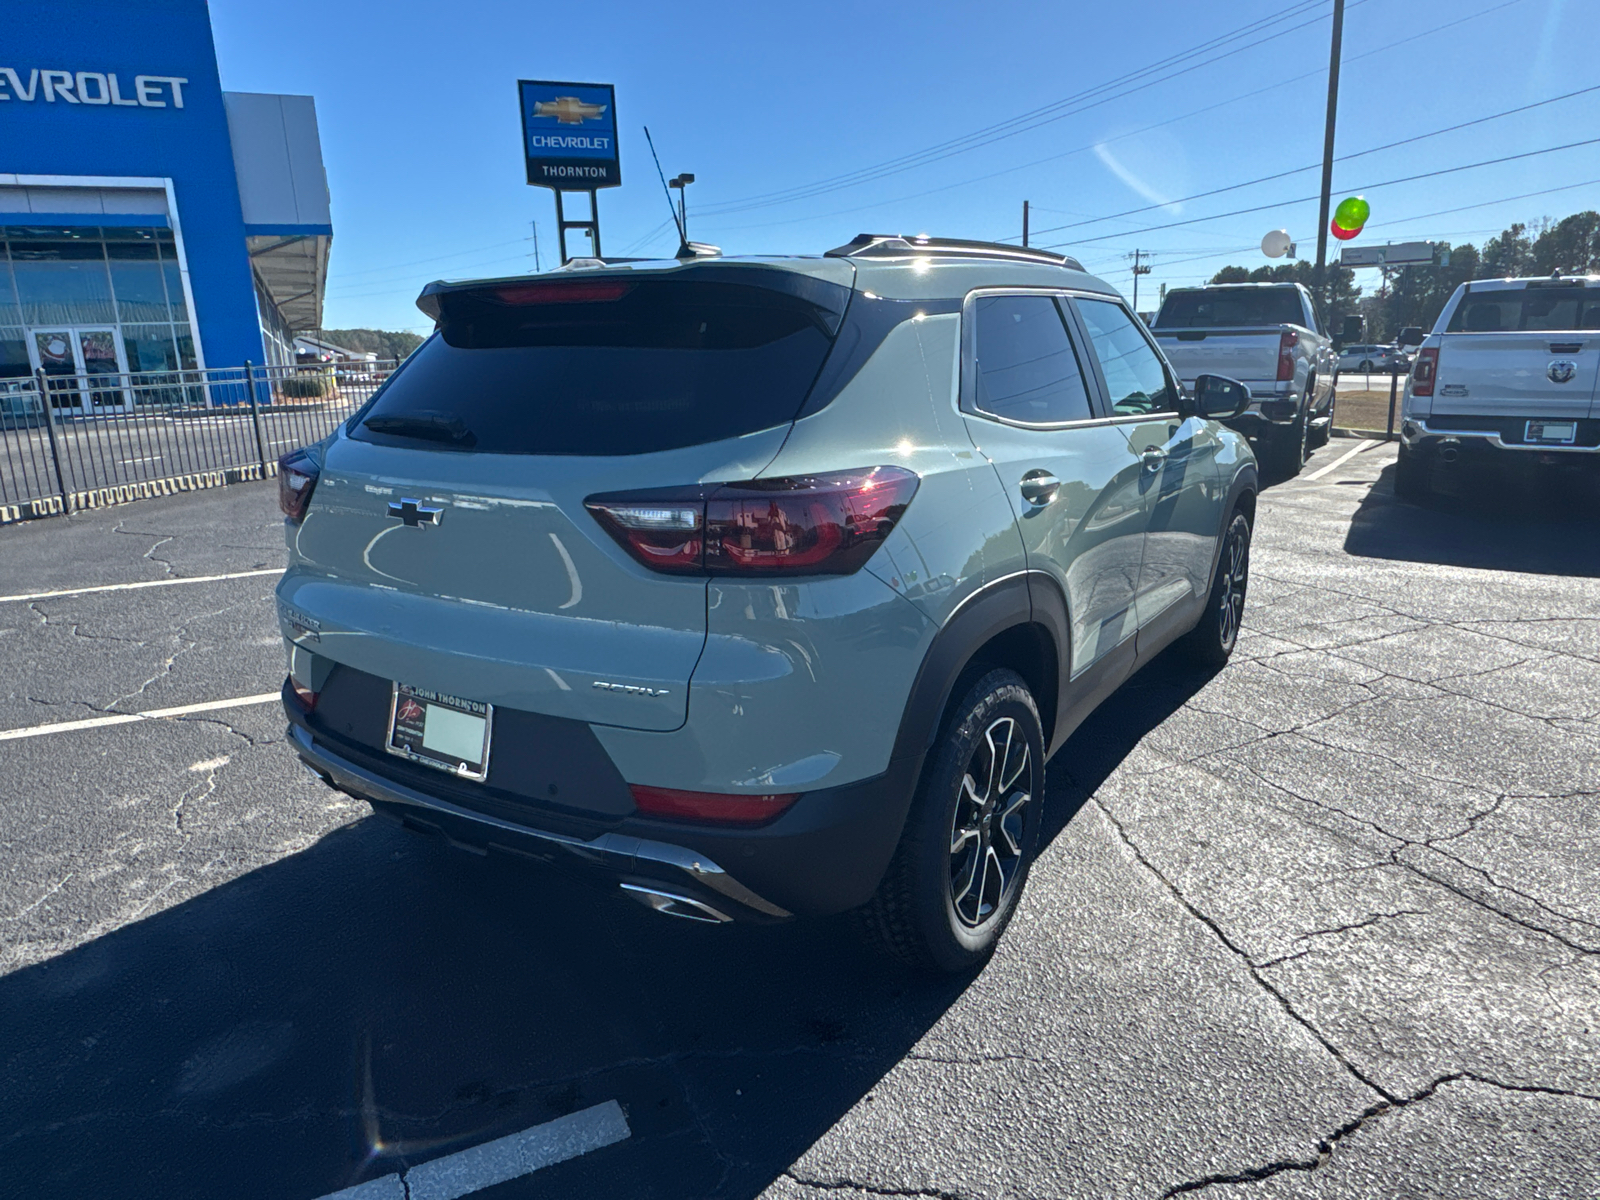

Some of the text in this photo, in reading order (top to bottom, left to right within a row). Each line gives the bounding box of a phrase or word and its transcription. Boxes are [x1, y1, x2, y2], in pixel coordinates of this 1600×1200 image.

[532, 135, 610, 150] CHEVROLET
[541, 165, 607, 178] THORNTON
[414, 687, 436, 700] JOHN
[592, 681, 670, 697] ACTIV
